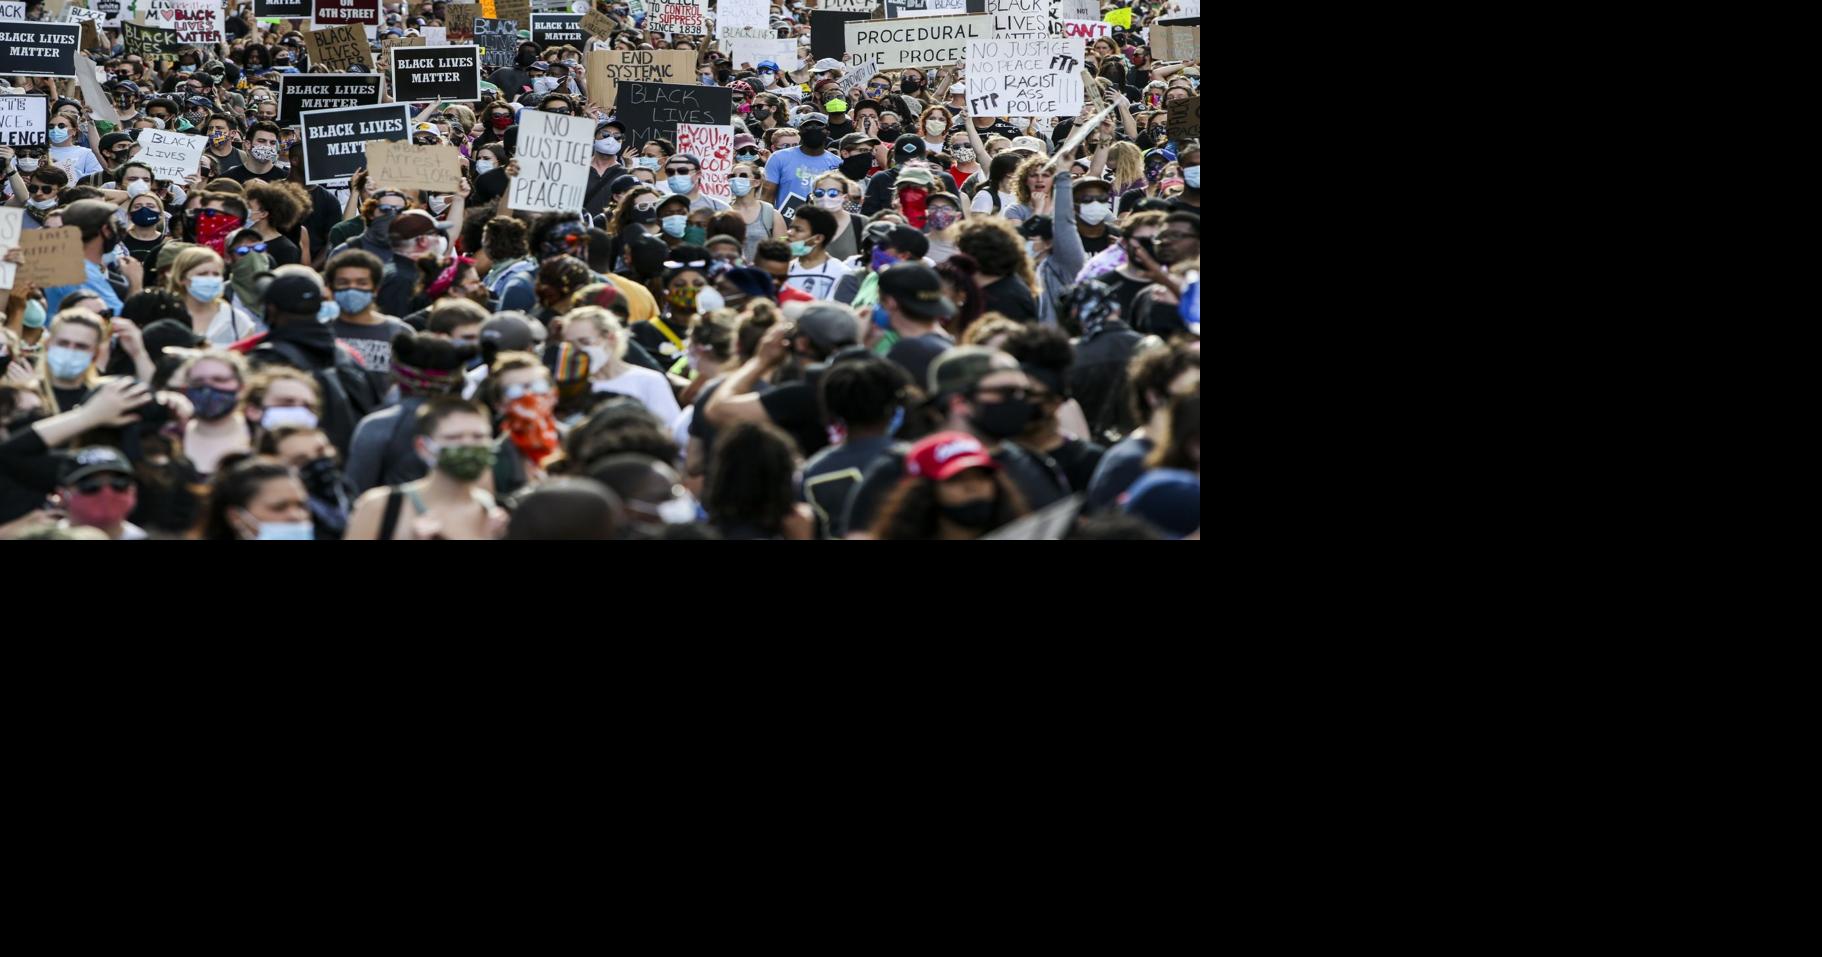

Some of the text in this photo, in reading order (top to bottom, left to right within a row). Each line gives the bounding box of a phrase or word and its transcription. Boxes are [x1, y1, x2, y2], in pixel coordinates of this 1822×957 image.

[319, 8, 375, 18] 4TH STREET
[665, 5, 702, 16] CONTROL
[988, 0, 1042, 13] BLACK
[174, 9, 216, 20] BLACK
[659, 14, 702, 25] SUPPRESS
[174, 21, 214, 31] LIVES
[474, 18, 518, 35] BLACK
[534, 22, 561, 30] BLACK
[650, 22, 702, 34] SINCE 1838
[995, 15, 1046, 30] LIVES
[0, 32, 75, 45] BLACK LIVES
[125, 23, 176, 45] BLACK
[314, 26, 355, 47] BLACK
[545, 32, 582, 40] MATTER
[857, 23, 979, 45] PROCEDURAL
[9, 46, 60, 58] MATTER
[319, 43, 360, 61] LIVES
[972, 41, 1072, 58] NO JUSTICE
[397, 56, 474, 70] BLACK LIVES
[621, 51, 653, 64] END
[1049, 54, 1079, 74] FTP
[606, 64, 674, 79] SYSTEMIC
[971, 60, 1044, 73] NO PEACE
[411, 72, 460, 84] MATTER
[970, 76, 997, 95] NO
[1004, 73, 1058, 91] RACIST
[286, 85, 375, 95] BLACK LIVES
[631, 83, 700, 106] BLACK
[1016, 89, 1045, 100] ASS
[301, 98, 358, 108] MATTER
[970, 92, 999, 115] FTP
[1007, 100, 1057, 114] POLICE
[653, 108, 715, 124] LIVES
[309, 118, 403, 139] BLACK LIVES
[543, 114, 570, 137] NO
[151, 132, 196, 150] BLACK
[688, 125, 718, 149] YOU
[145, 146, 186, 161] LIVES
[517, 135, 591, 167] JUSTICE
[153, 166, 186, 179] ATTER
[537, 160, 562, 182] NO
